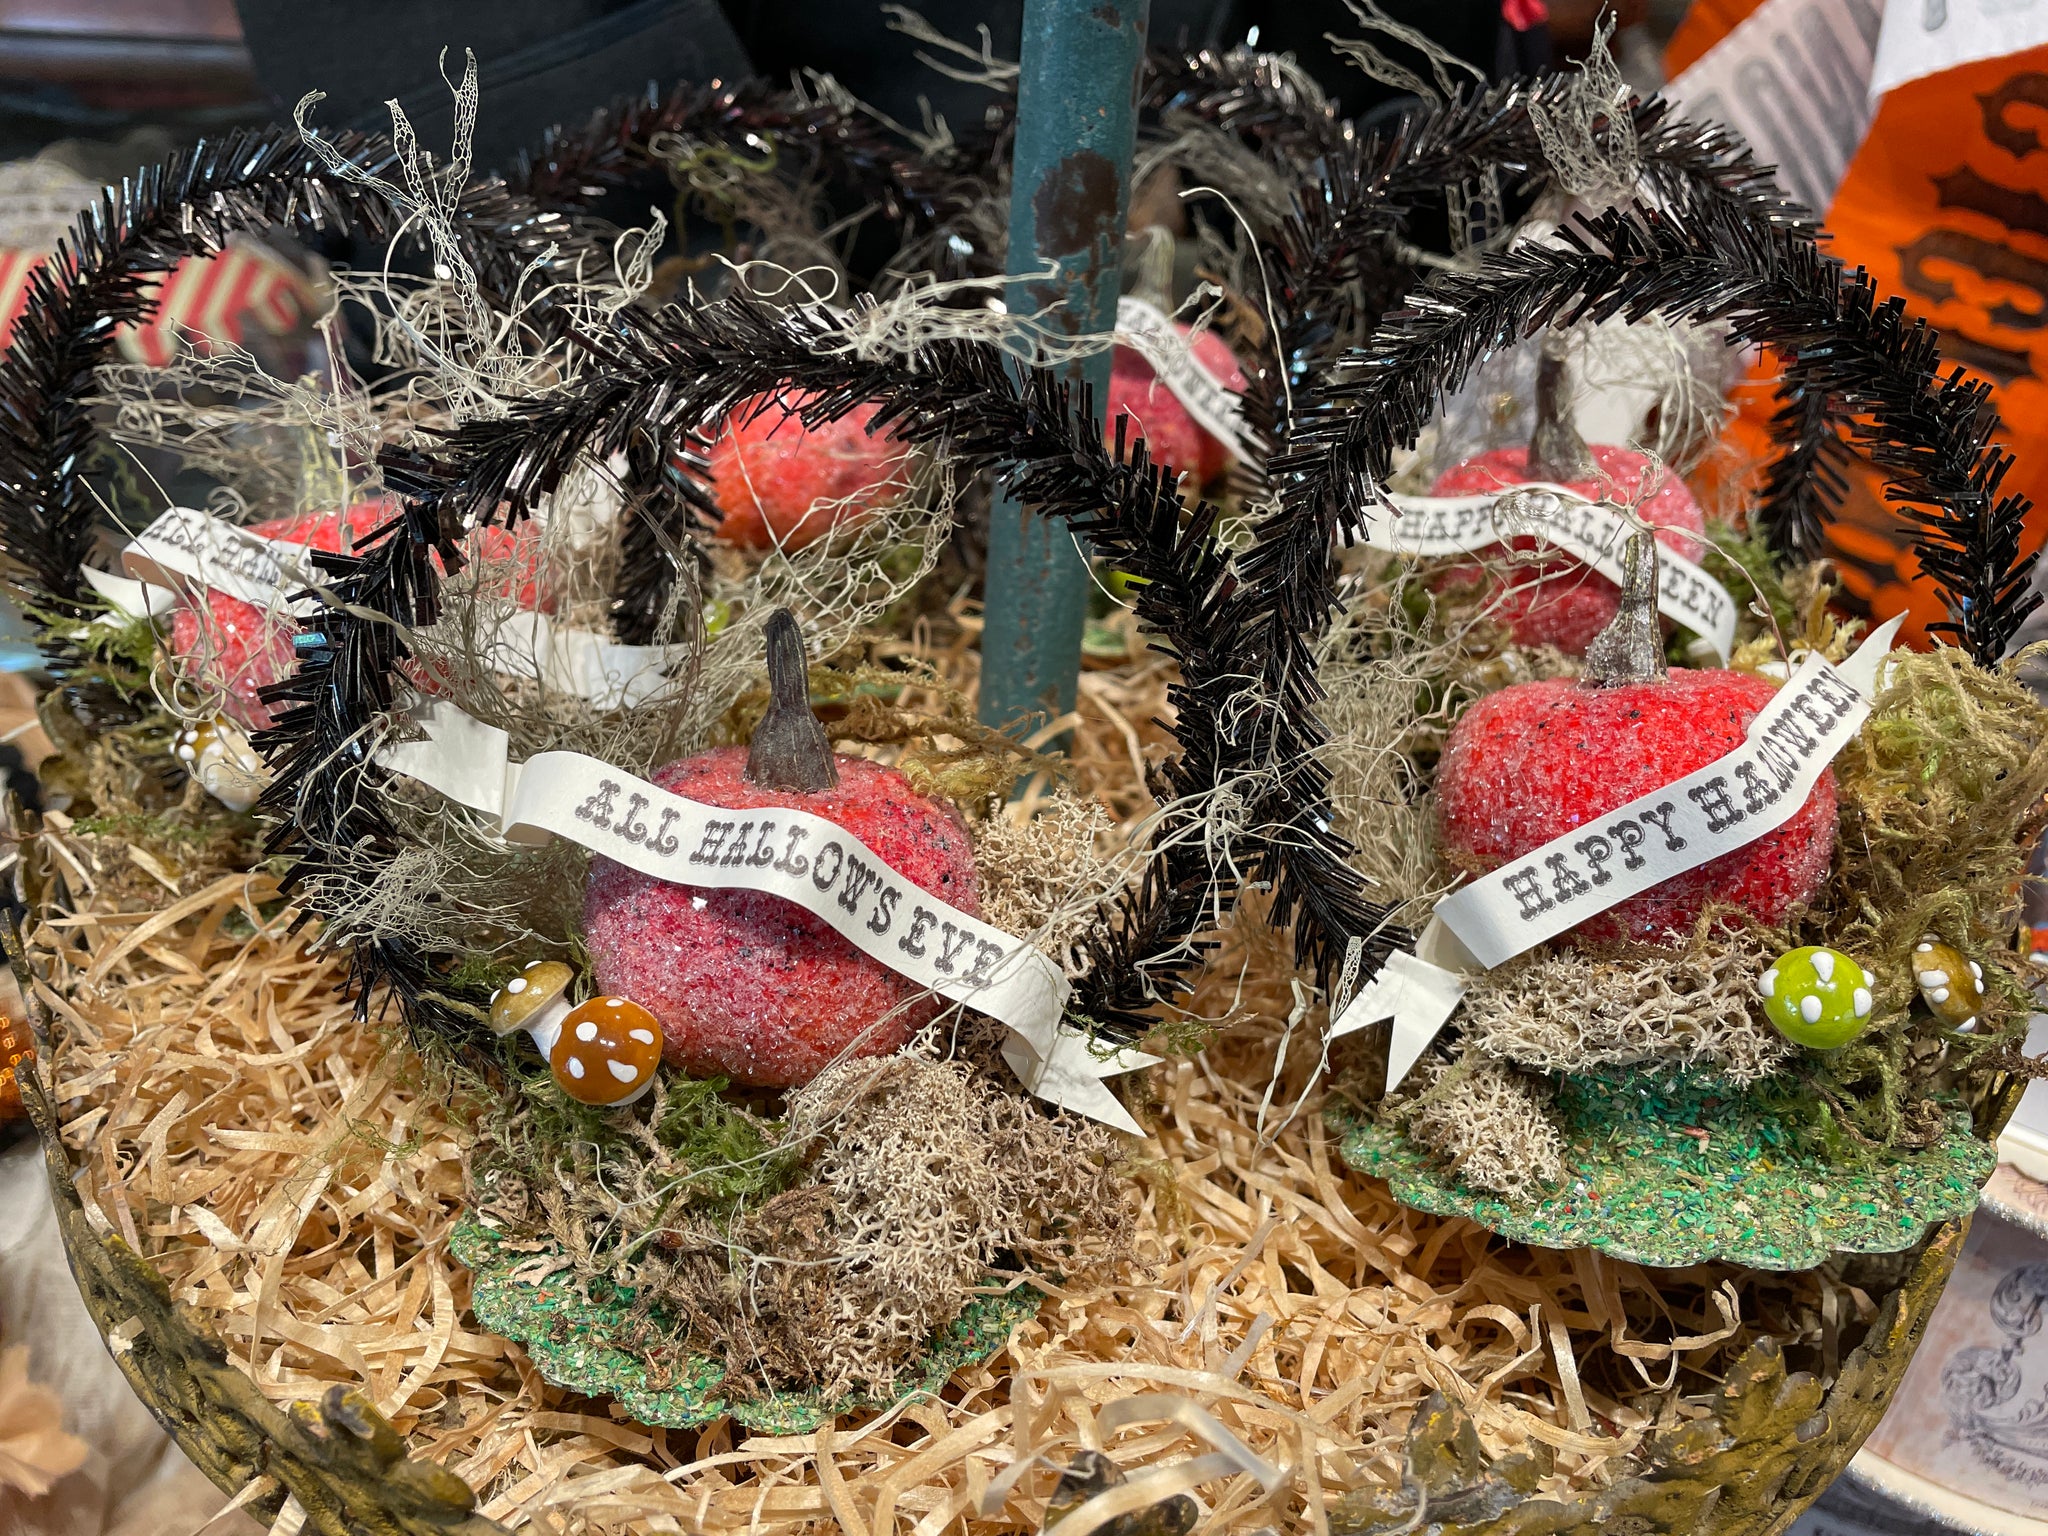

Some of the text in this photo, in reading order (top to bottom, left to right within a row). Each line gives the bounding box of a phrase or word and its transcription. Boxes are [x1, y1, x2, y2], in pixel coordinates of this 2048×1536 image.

[574, 778, 1007, 992] ALL HALLOW'S EVE
[1502, 800, 1688, 923] HAPPY
